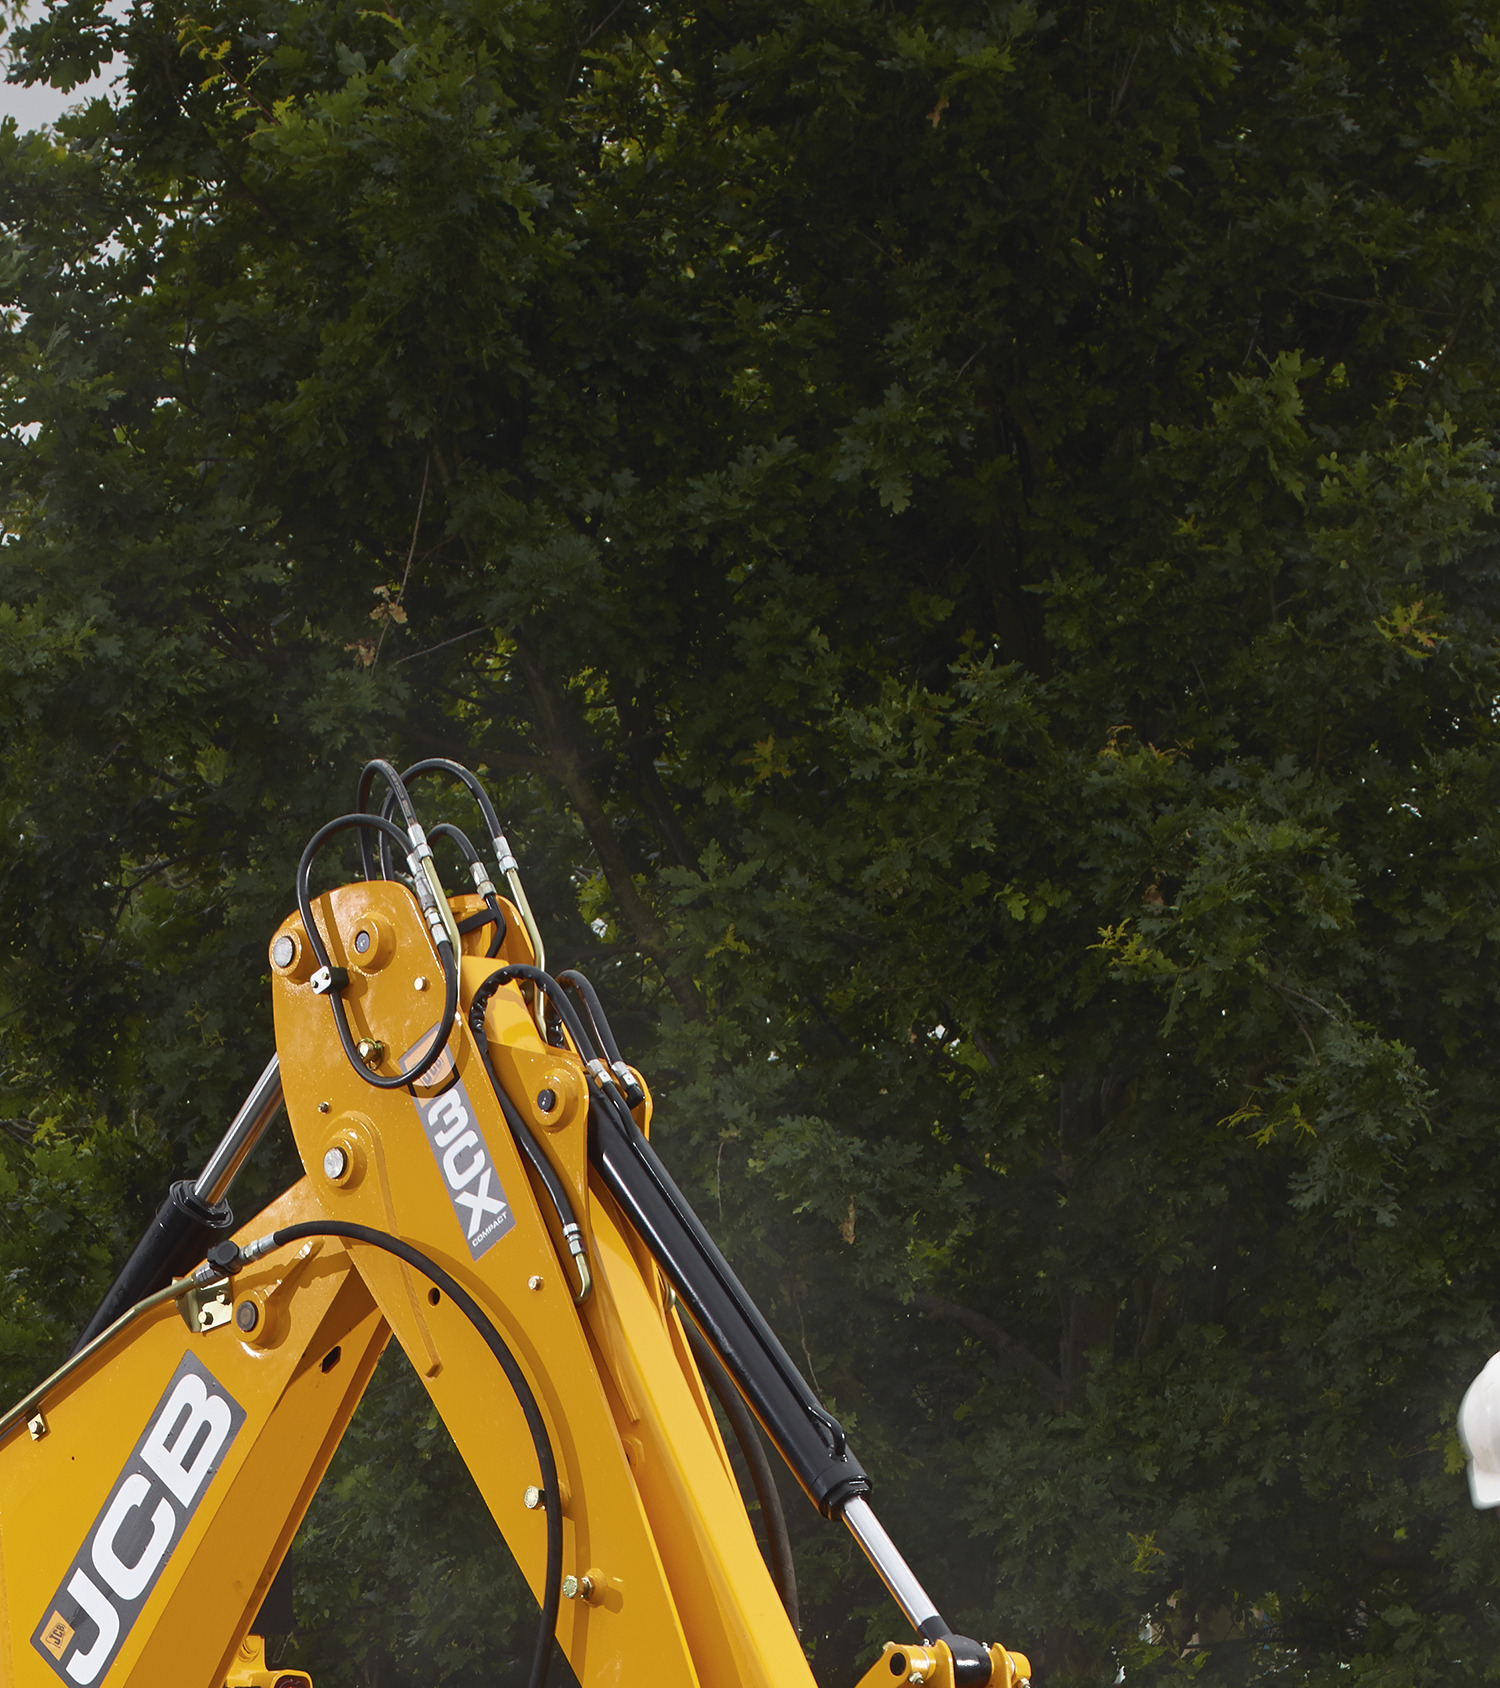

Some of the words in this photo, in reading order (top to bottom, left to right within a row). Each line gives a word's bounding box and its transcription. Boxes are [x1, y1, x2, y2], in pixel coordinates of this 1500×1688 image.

[428, 1088, 507, 1240] 3CX
[471, 1211, 508, 1248] COMPACT
[65, 1373, 232, 1686] JCB
[48, 1624, 65, 1646] JCB
